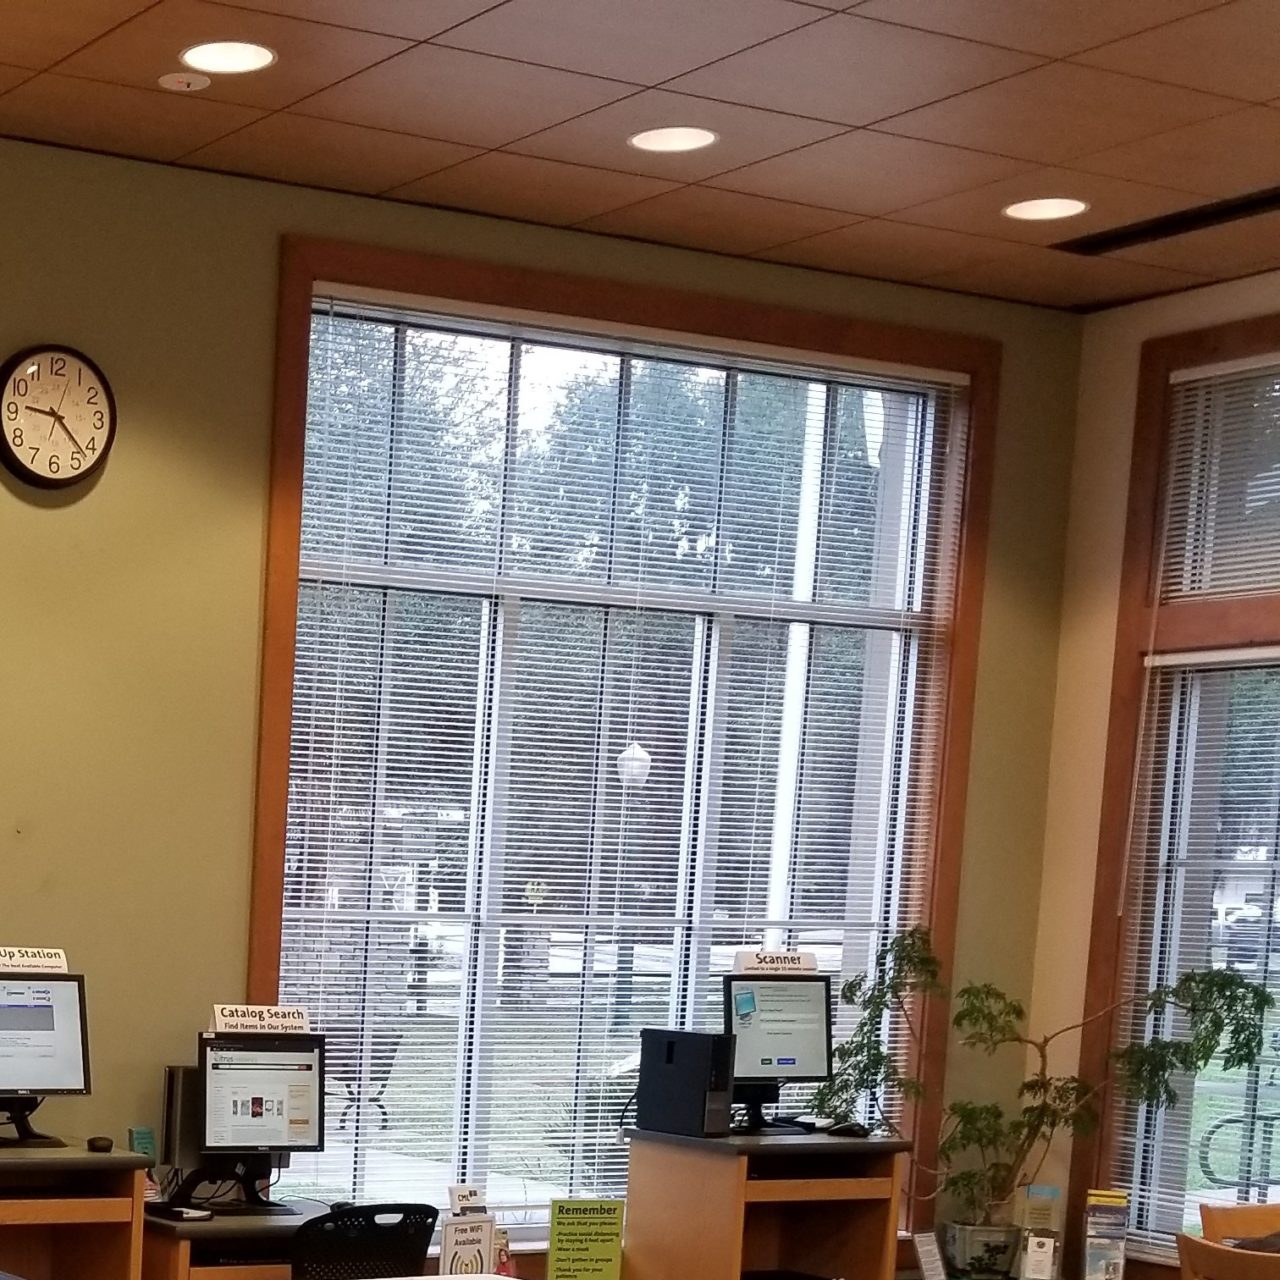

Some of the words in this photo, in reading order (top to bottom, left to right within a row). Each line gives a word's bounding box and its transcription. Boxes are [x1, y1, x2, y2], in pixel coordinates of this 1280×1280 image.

[30, 361, 41, 382] 11
[49, 356, 67, 378] 12
[12, 377, 29, 397] 10
[86, 386, 99, 406] 2
[6, 401, 19, 422] 9
[92, 410, 105, 431] 3
[12, 427, 24, 448] 8
[85, 436, 98, 456] 4
[28, 446, 41, 465] 7
[48, 455, 61, 474] 6
[70, 451, 82, 471] 5
[17, 948, 62, 960] Station
[755, 952, 802, 965] Scanner
[220, 1007, 266, 1022] Catalog
[267, 1008, 304, 1020] Search
[224, 1022, 239, 1030] Find
[239, 1022, 258, 1030] Items
[267, 1023, 280, 1031] Our
[280, 1023, 304, 1032] System
[557, 1204, 618, 1216] Remember
